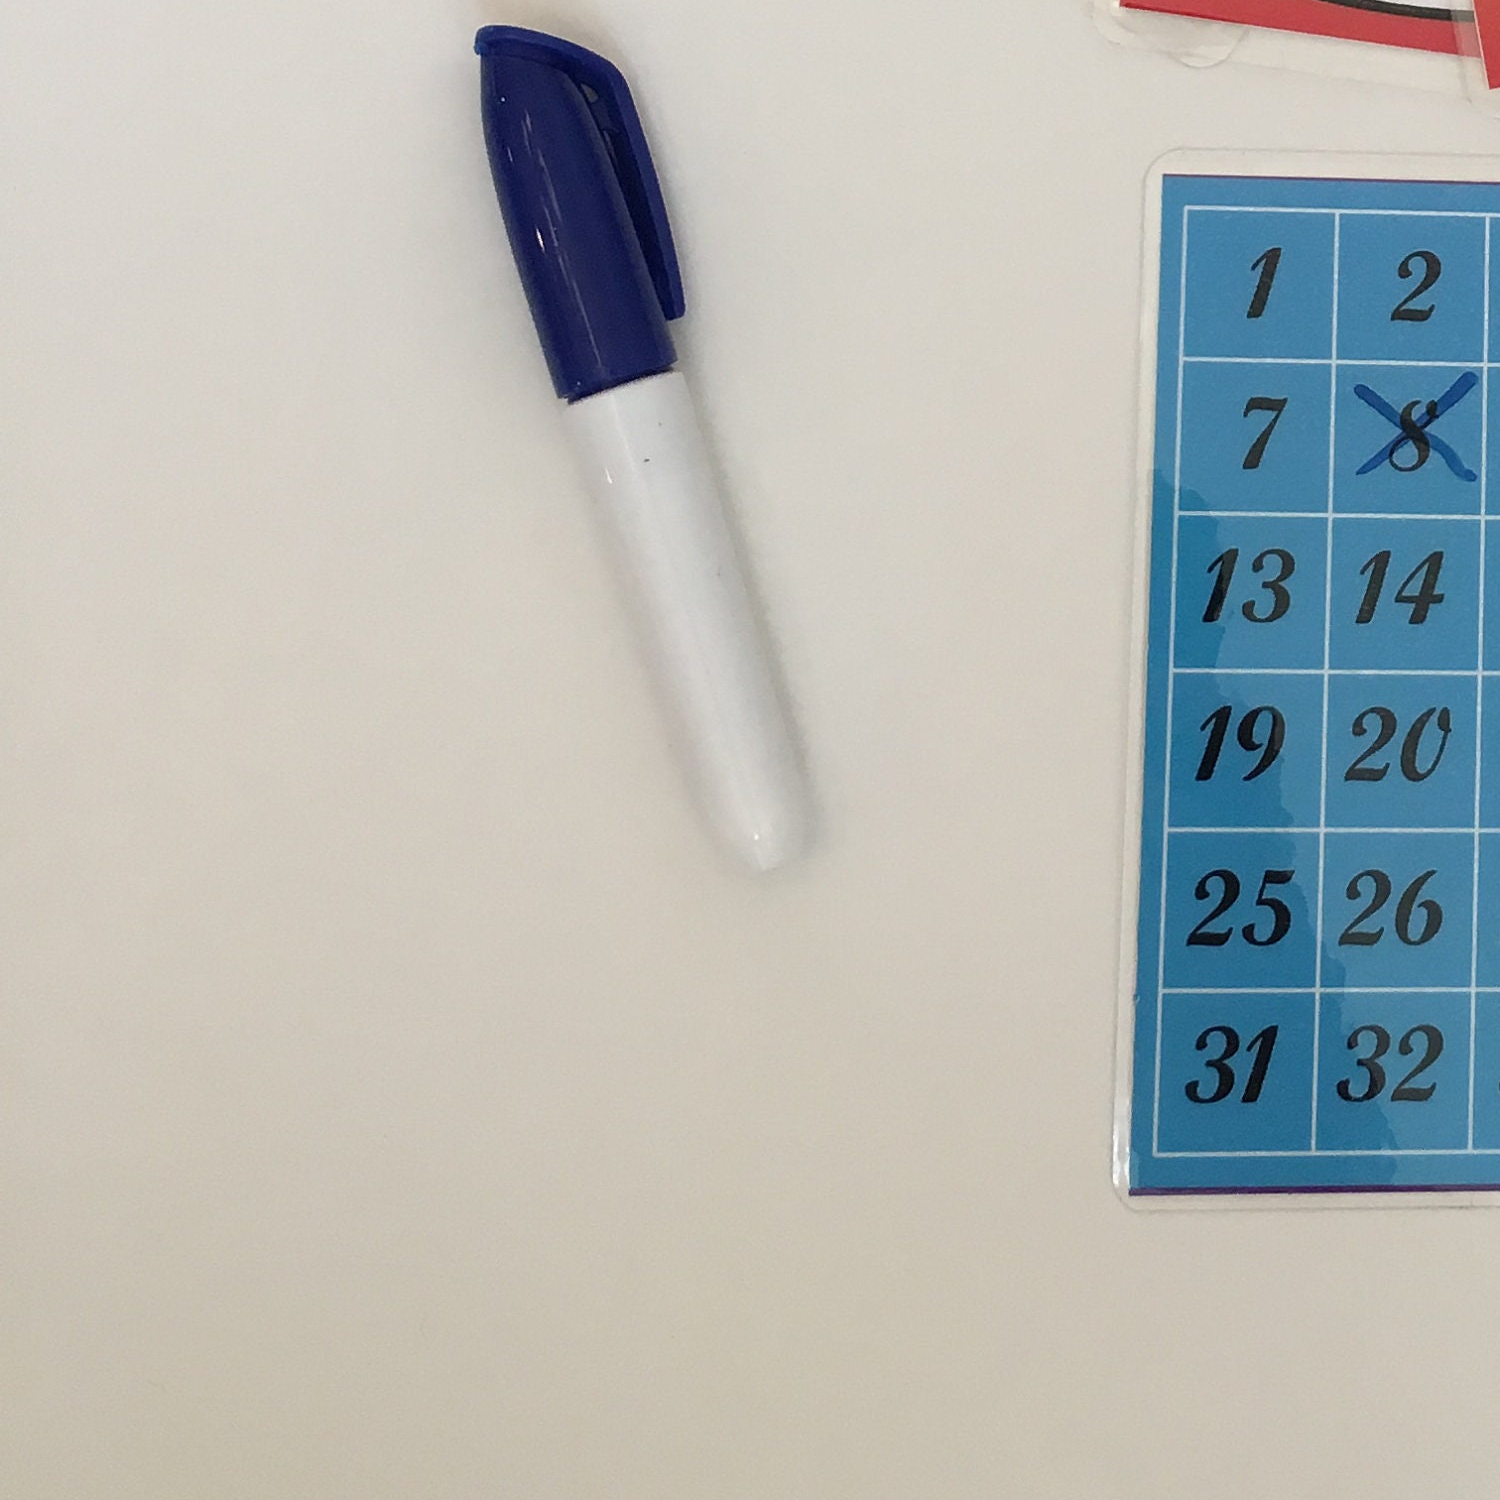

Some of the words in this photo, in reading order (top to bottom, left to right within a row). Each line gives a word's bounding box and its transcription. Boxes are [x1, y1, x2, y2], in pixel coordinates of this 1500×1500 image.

[1247, 248, 1282, 318] 1
[1391, 251, 1442, 322] 2
[1241, 397, 1288, 469] 7
[1387, 399, 1440, 472] 8
[1202, 549, 1295, 623] 13
[1356, 551, 1444, 624] 14
[1195, 706, 1285, 781] 19
[1344, 707, 1451, 782] 20
[1186, 869, 1295, 946] 25
[1338, 870, 1443, 946] 26
[1185, 1025, 1279, 1104] 31
[1336, 1025, 1443, 1102] 32
